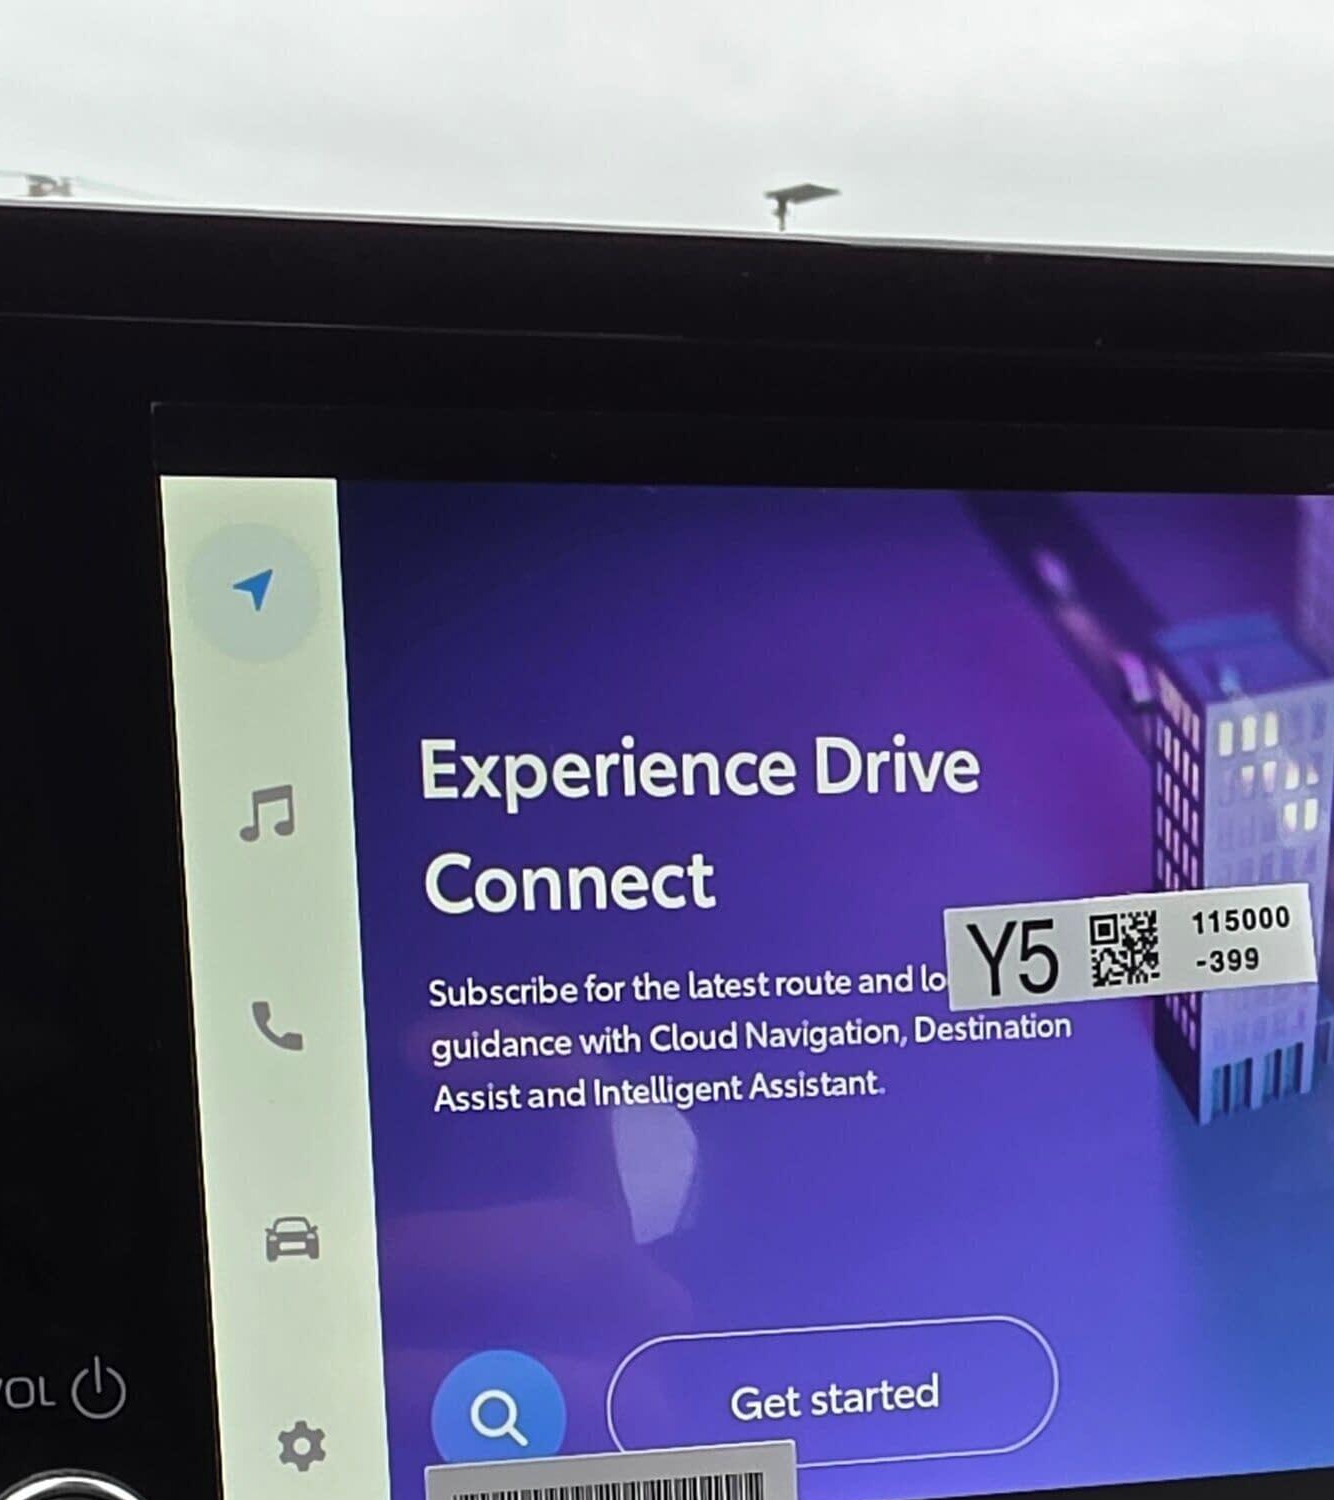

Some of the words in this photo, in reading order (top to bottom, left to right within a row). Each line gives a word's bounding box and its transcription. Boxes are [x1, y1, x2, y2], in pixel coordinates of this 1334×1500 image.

[420, 734, 797, 814] Experience
[814, 733, 981, 797] Drive
[424, 852, 716, 914] Connect
[1191, 905, 1291, 935] 115000
[967, 919, 1059, 997] Y5
[1196, 947, 1260, 974] -399
[428, 975, 579, 1008] Subscribe
[583, 975, 627, 1004] for
[632, 972, 681, 1002] the
[688, 970, 771, 1001] latest
[775, 970, 853, 998] route
[857, 967, 915, 996] and
[920, 965, 948, 994] lo
[431, 1028, 573, 1068] guidance
[579, 1025, 643, 1056] with
[649, 1022, 739, 1053] Cloud
[745, 1017, 908, 1058] Navigation,
[914, 1013, 1073, 1044] Destination
[434, 1082, 523, 1113] Assist
[527, 1080, 586, 1110] and
[593, 1073, 743, 1112] Intelligent
[749, 1070, 886, 1099] Assistant.
[731, 1386, 802, 1422] Get
[810, 1372, 940, 1415] started
